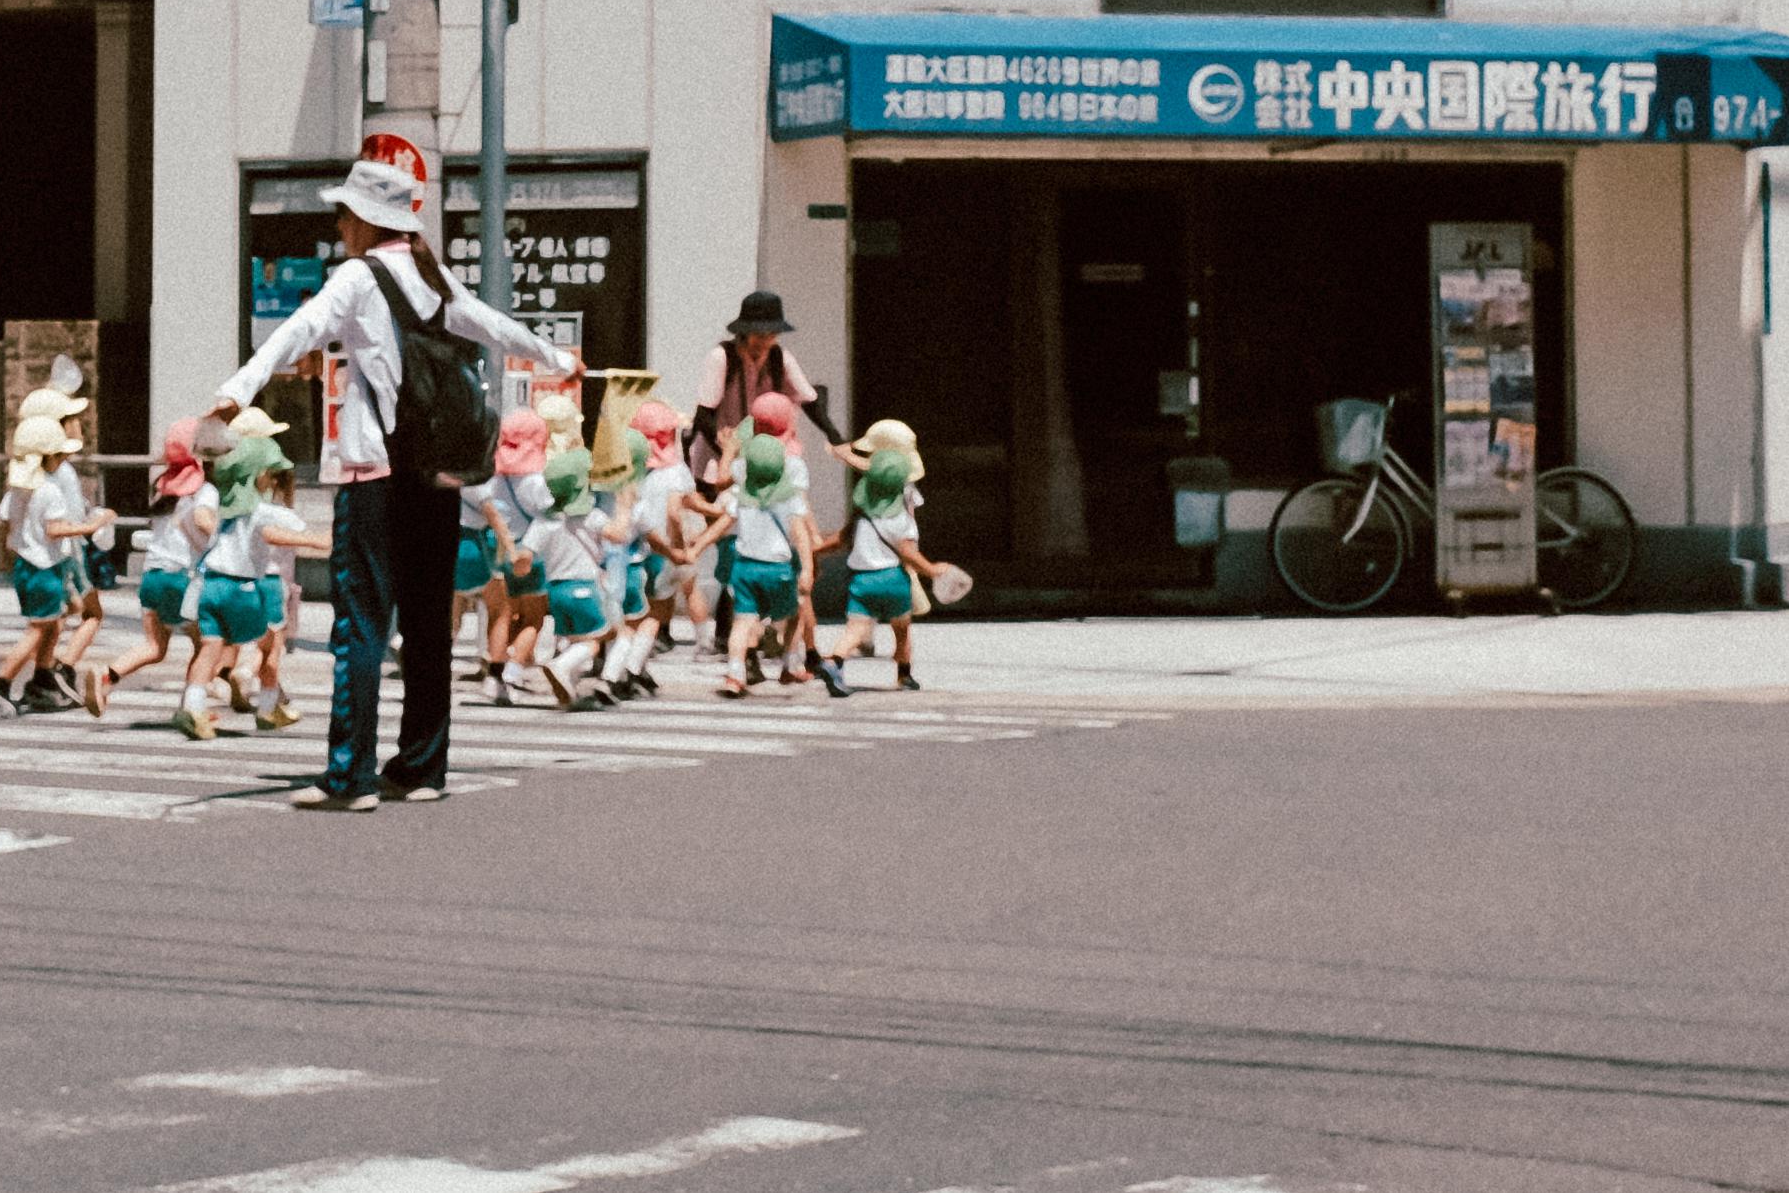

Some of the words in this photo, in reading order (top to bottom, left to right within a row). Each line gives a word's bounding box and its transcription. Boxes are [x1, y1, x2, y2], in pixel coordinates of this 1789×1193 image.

[1317, 58, 1658, 134] 中央国際旅行
